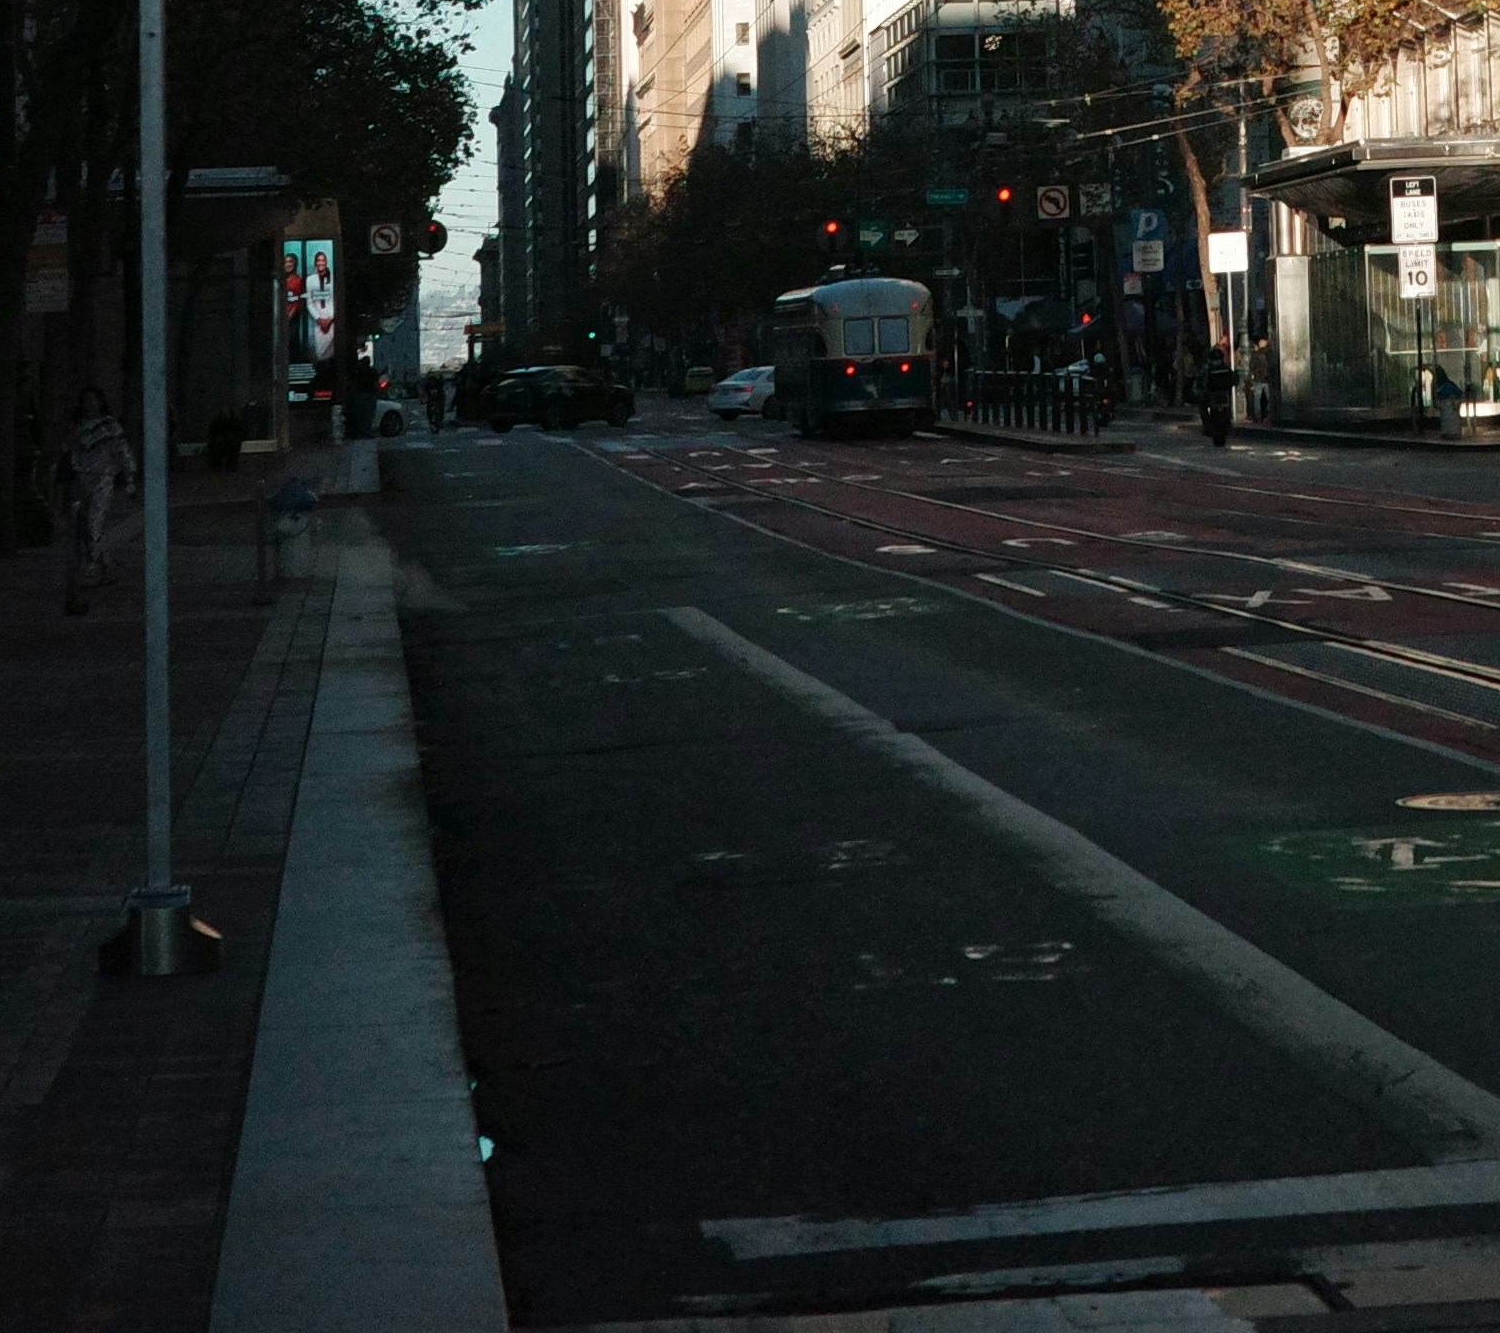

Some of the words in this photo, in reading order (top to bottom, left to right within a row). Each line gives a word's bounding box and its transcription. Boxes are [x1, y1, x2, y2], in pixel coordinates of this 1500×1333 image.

[1402, 249, 1432, 259] SPEED
[1405, 259, 1429, 269] LIMIT
[1407, 270, 1429, 287] 10
